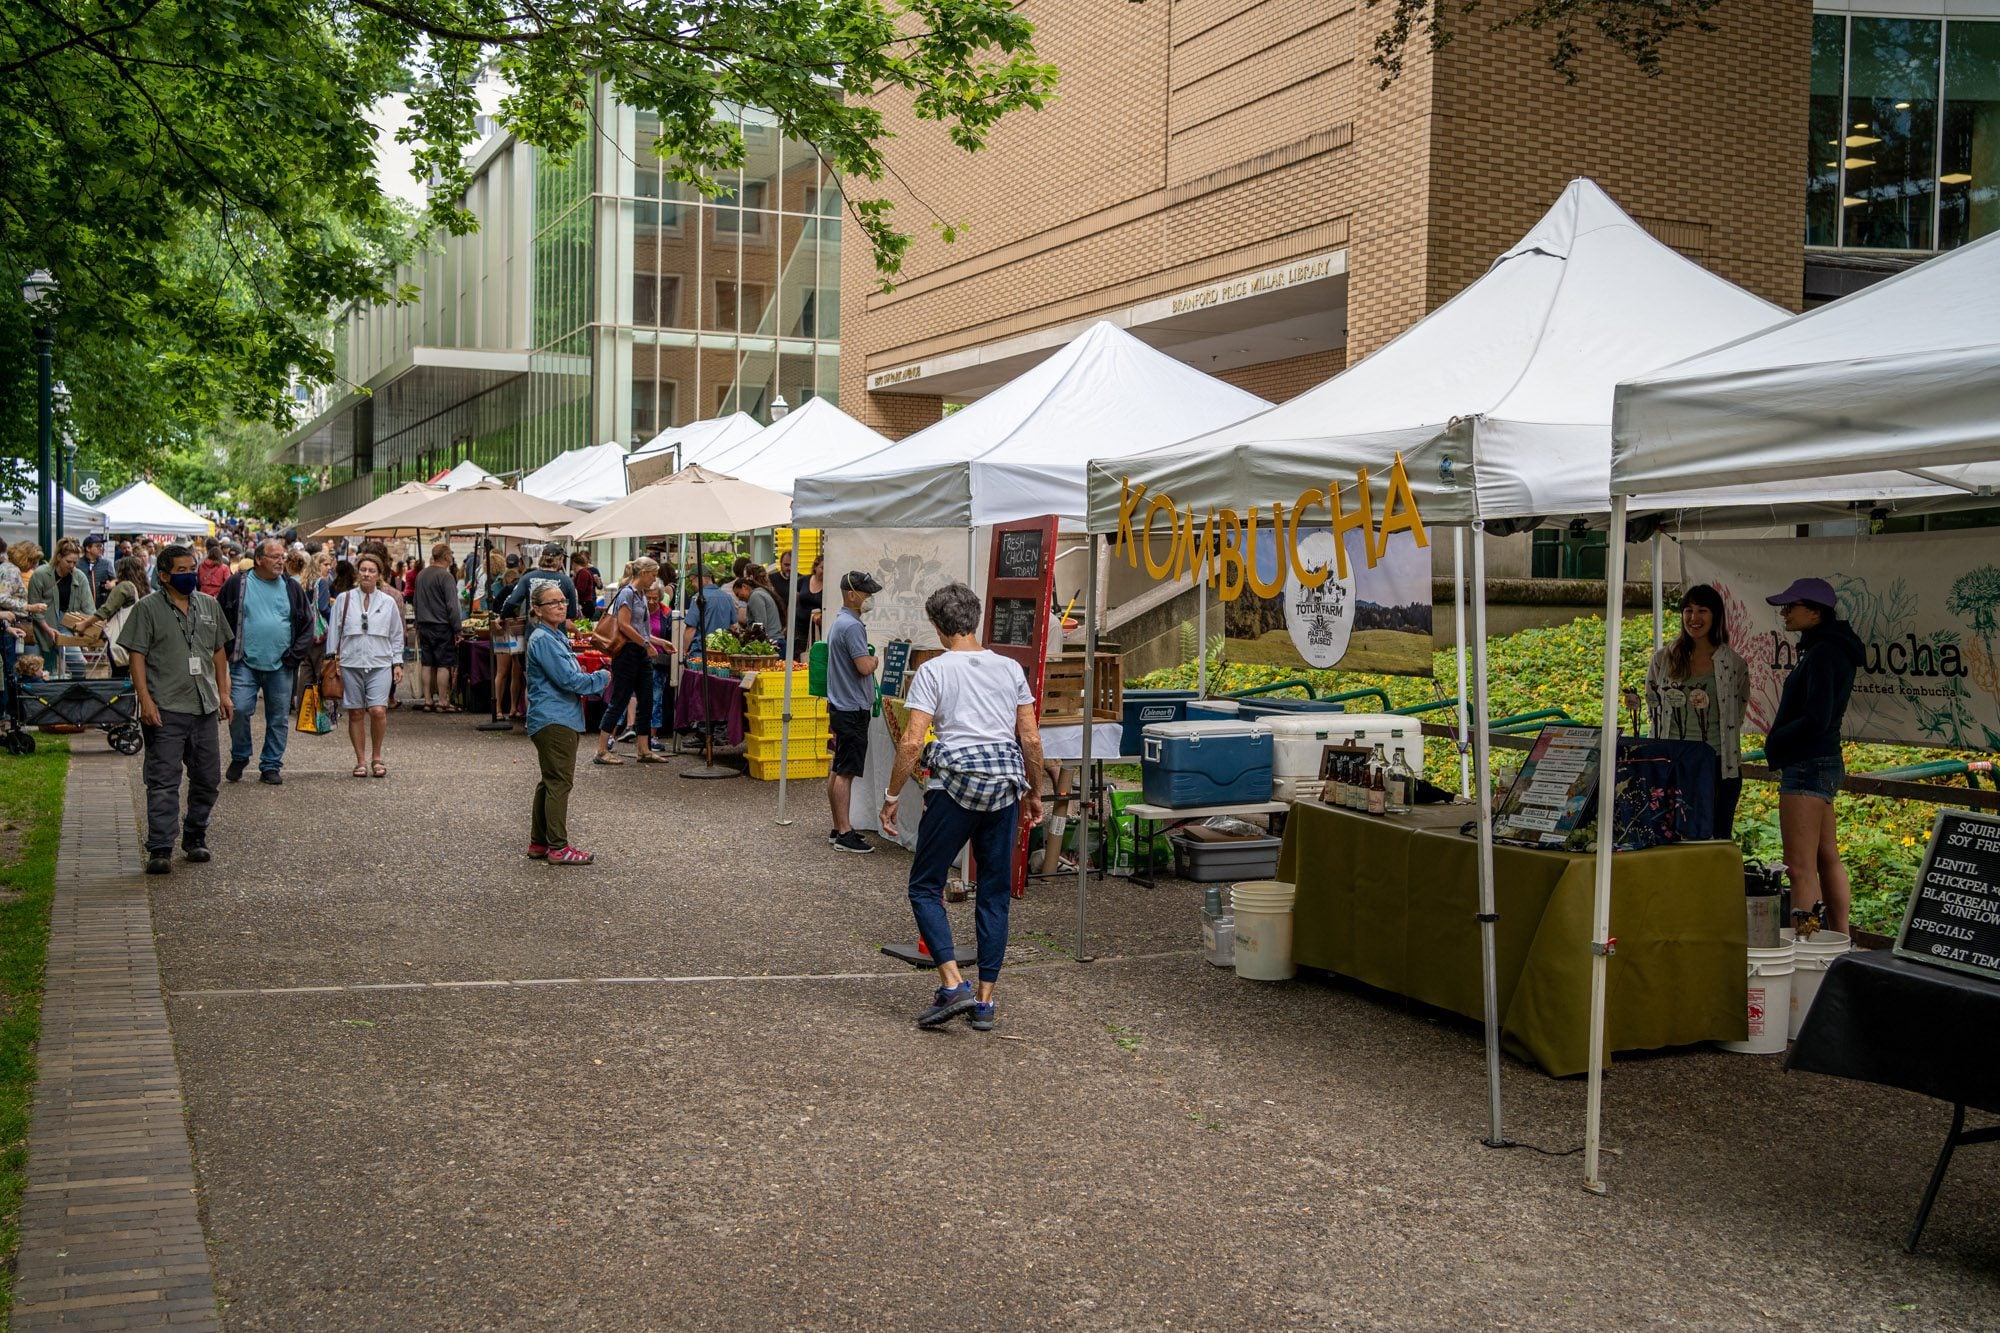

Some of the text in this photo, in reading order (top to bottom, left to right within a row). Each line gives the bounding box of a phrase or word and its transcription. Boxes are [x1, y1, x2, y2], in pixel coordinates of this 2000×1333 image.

[1172, 259, 1331, 312] BRANFORD PRICE MILLAR LIBRARY
[1115, 450, 1430, 602] KOMBUCHA
[1002, 533, 1026, 552] FRESH
[1005, 547, 1039, 566] CHICKEN
[1012, 563, 1038, 577] TODAY!
[1296, 604, 1343, 617] TOTUM FARM
[1307, 630, 1333, 640] PASTURE
[1309, 637, 1331, 646] RAISED
[1770, 630, 1969, 678] hucha
[1852, 683, 1957, 697] crafted kombucha
[1143, 708, 1167, 716] Coleman
[1947, 834, 2000, 853] SOY FRE
[1934, 856, 1979, 876] LENTIL
[1926, 871, 1989, 894] CHICKPEA
[1921, 887, 1999, 913] BLACKBEAN
[1911, 917, 1975, 942] SPECIALS
[1931, 943, 2000, 970] @EAT TEM
